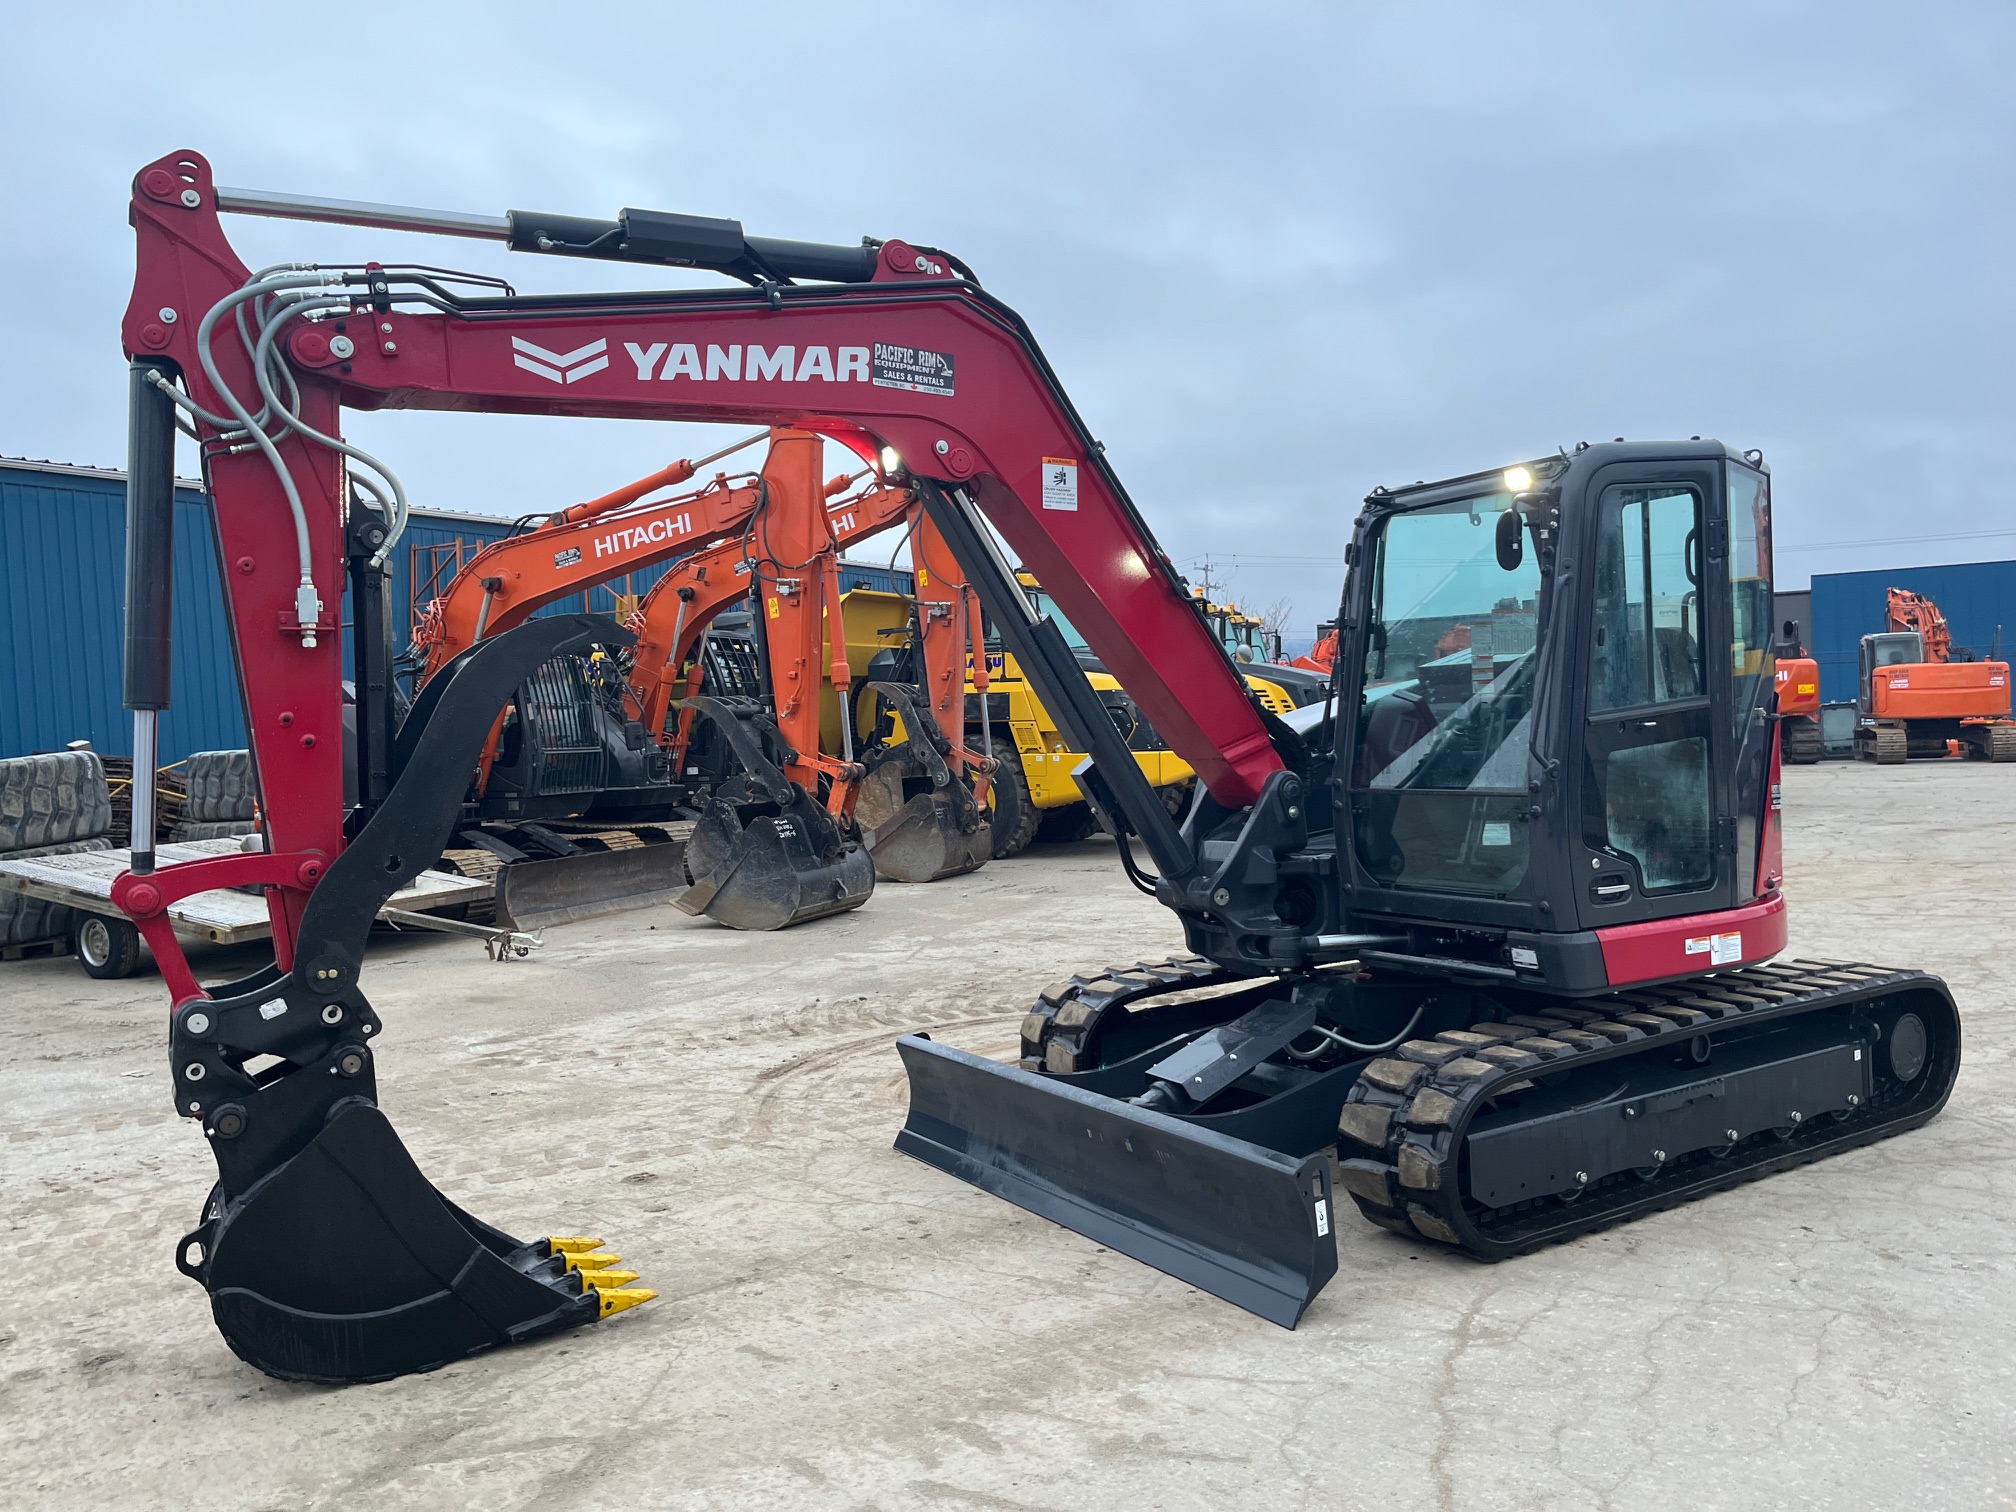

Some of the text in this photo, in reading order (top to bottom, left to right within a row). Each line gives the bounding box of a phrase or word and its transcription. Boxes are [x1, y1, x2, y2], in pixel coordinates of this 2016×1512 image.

[623, 342, 870, 382] YANMAR
[874, 343, 936, 368] PACIFIC RIM
[874, 359, 935, 374] EQUIPMENT
[883, 369, 944, 386] SALES & RENTALS
[594, 512, 692, 558] HITACHI
